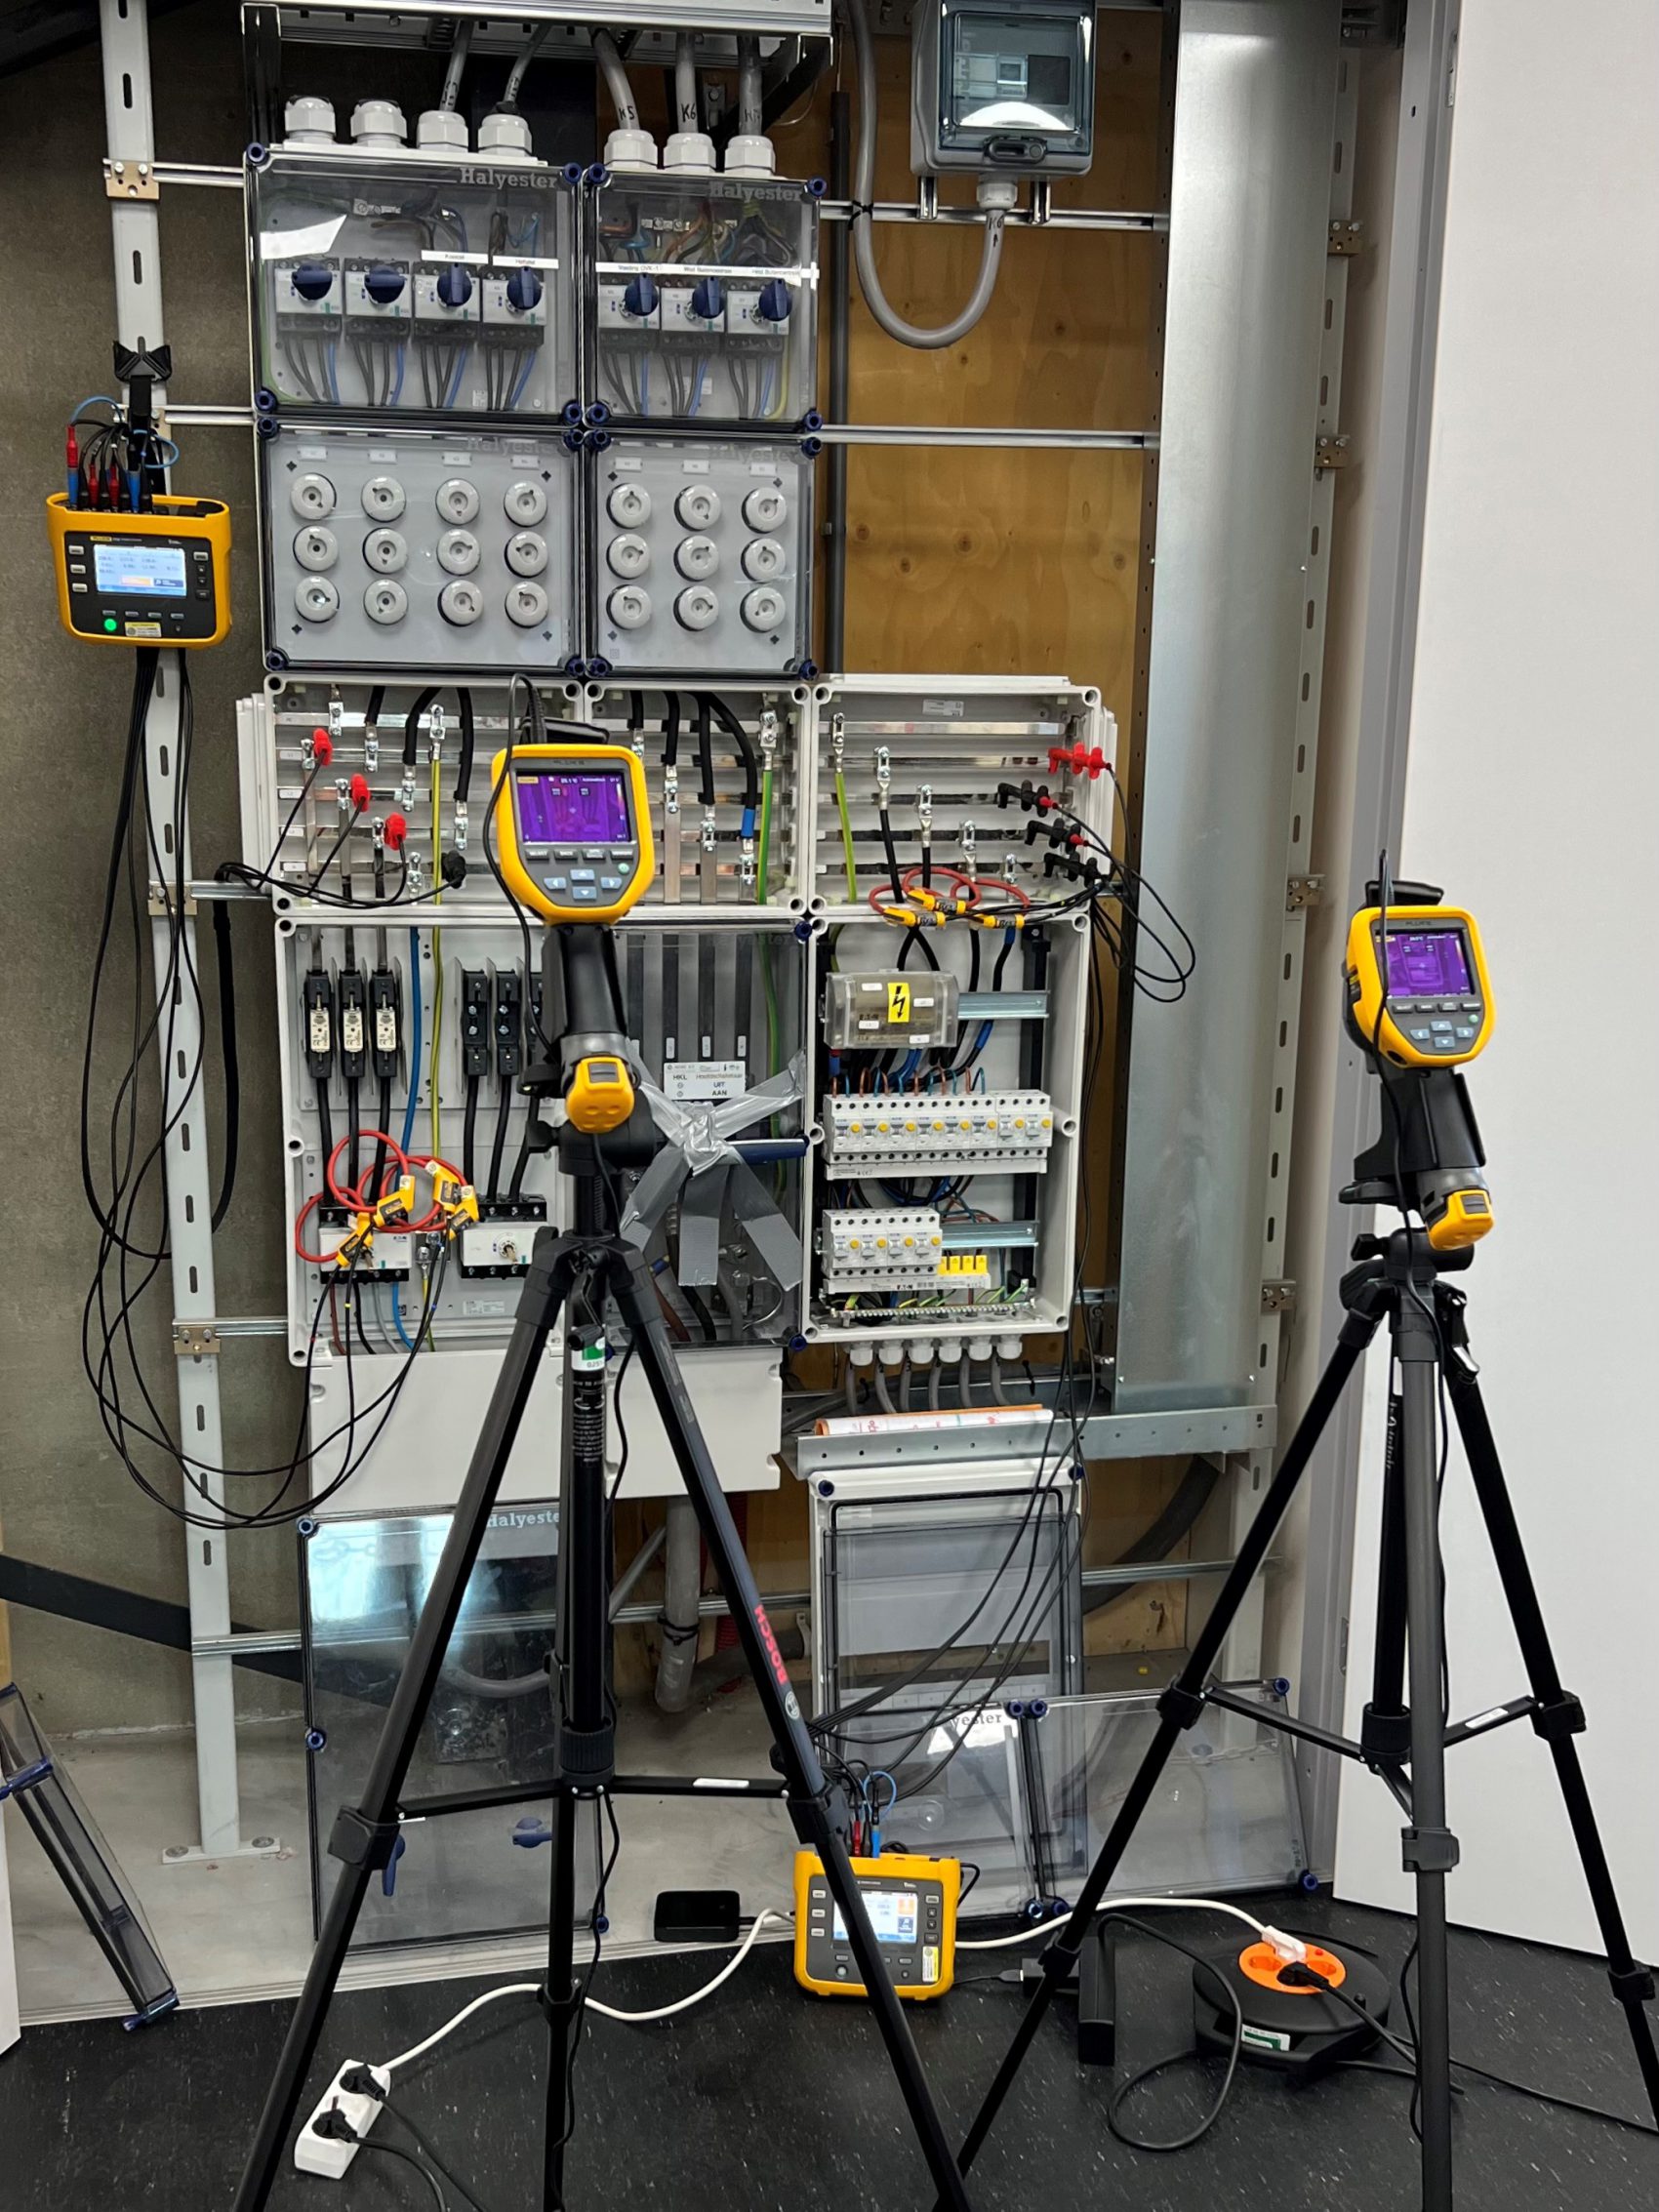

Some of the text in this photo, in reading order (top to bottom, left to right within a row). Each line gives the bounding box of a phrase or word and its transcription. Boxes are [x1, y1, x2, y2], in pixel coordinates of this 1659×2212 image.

[681, 103, 697, 123] K6
[460, 166, 558, 190] Halyester
[708, 180, 805, 203] Halyester
[487, 1510, 560, 1529] Halyeste
[753, 1602, 789, 1686] BOSCH
